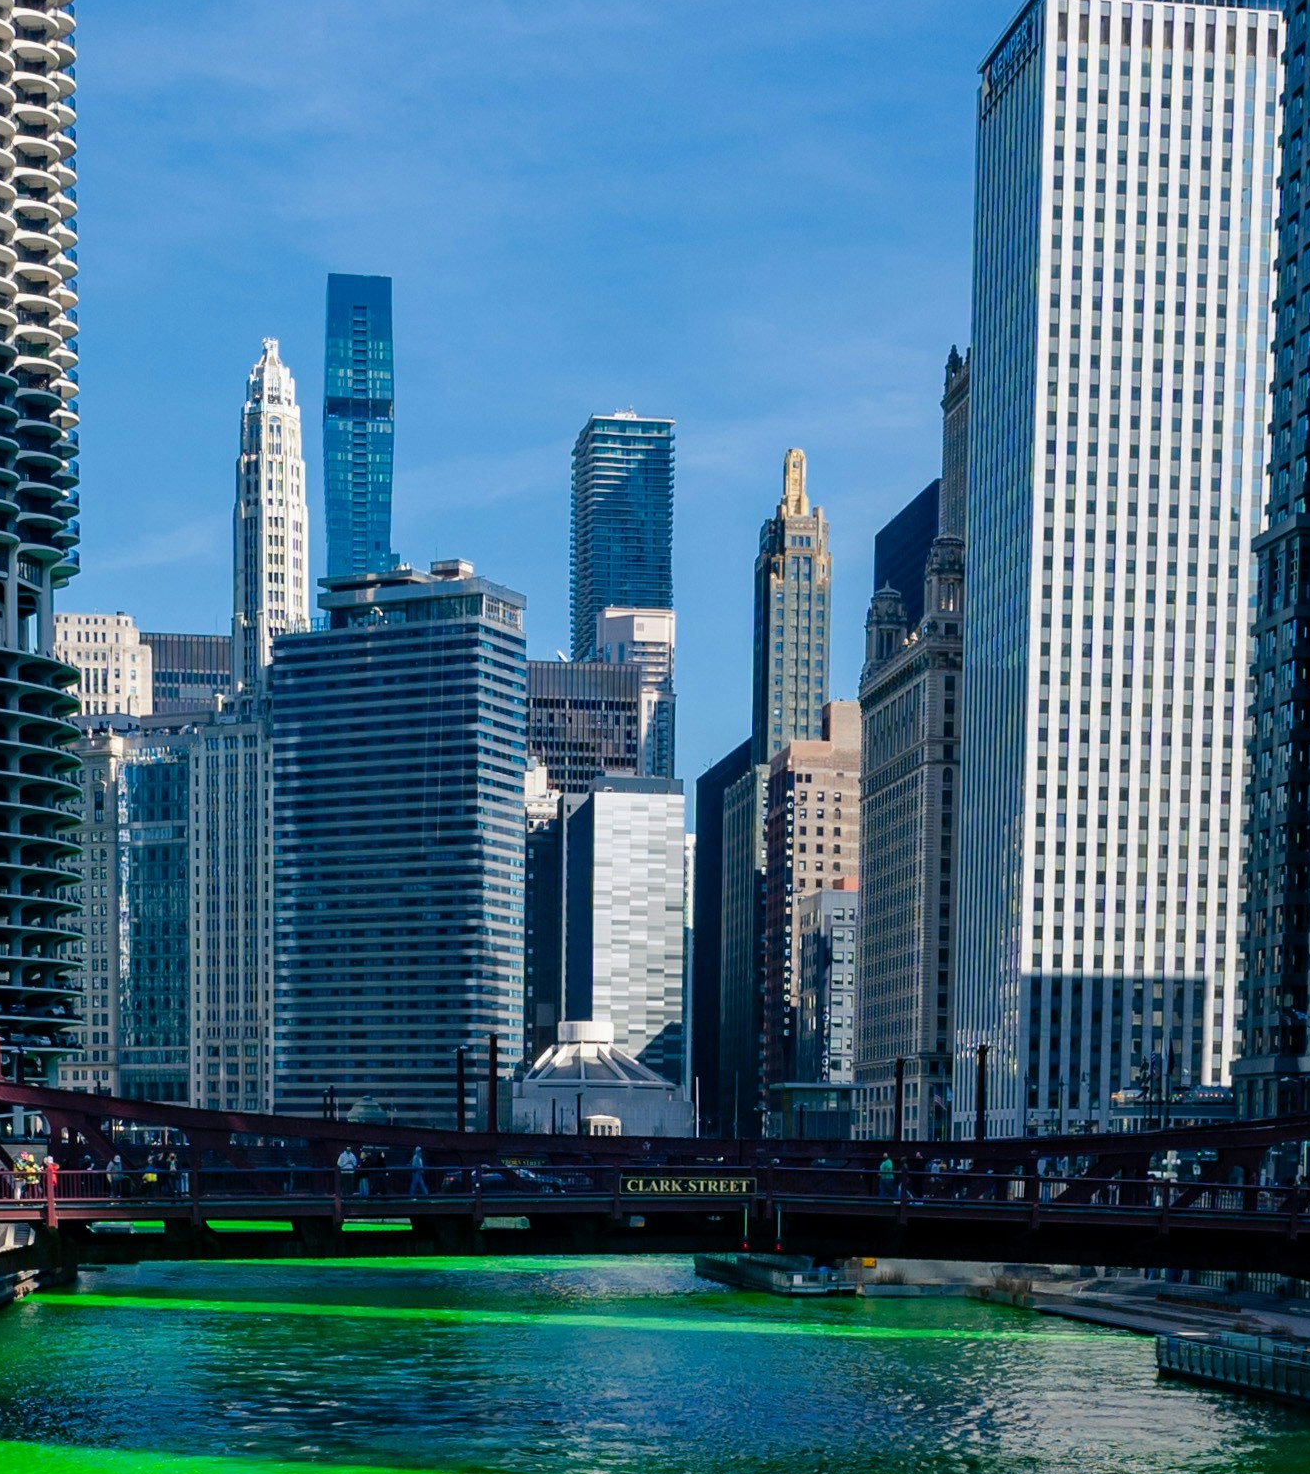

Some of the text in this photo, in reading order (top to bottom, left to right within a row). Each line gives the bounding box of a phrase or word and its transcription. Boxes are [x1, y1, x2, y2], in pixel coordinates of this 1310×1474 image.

[784, 925, 792, 1036] STEAKHOUSE
[626, 1179, 750, 1193] CLARK STREET
